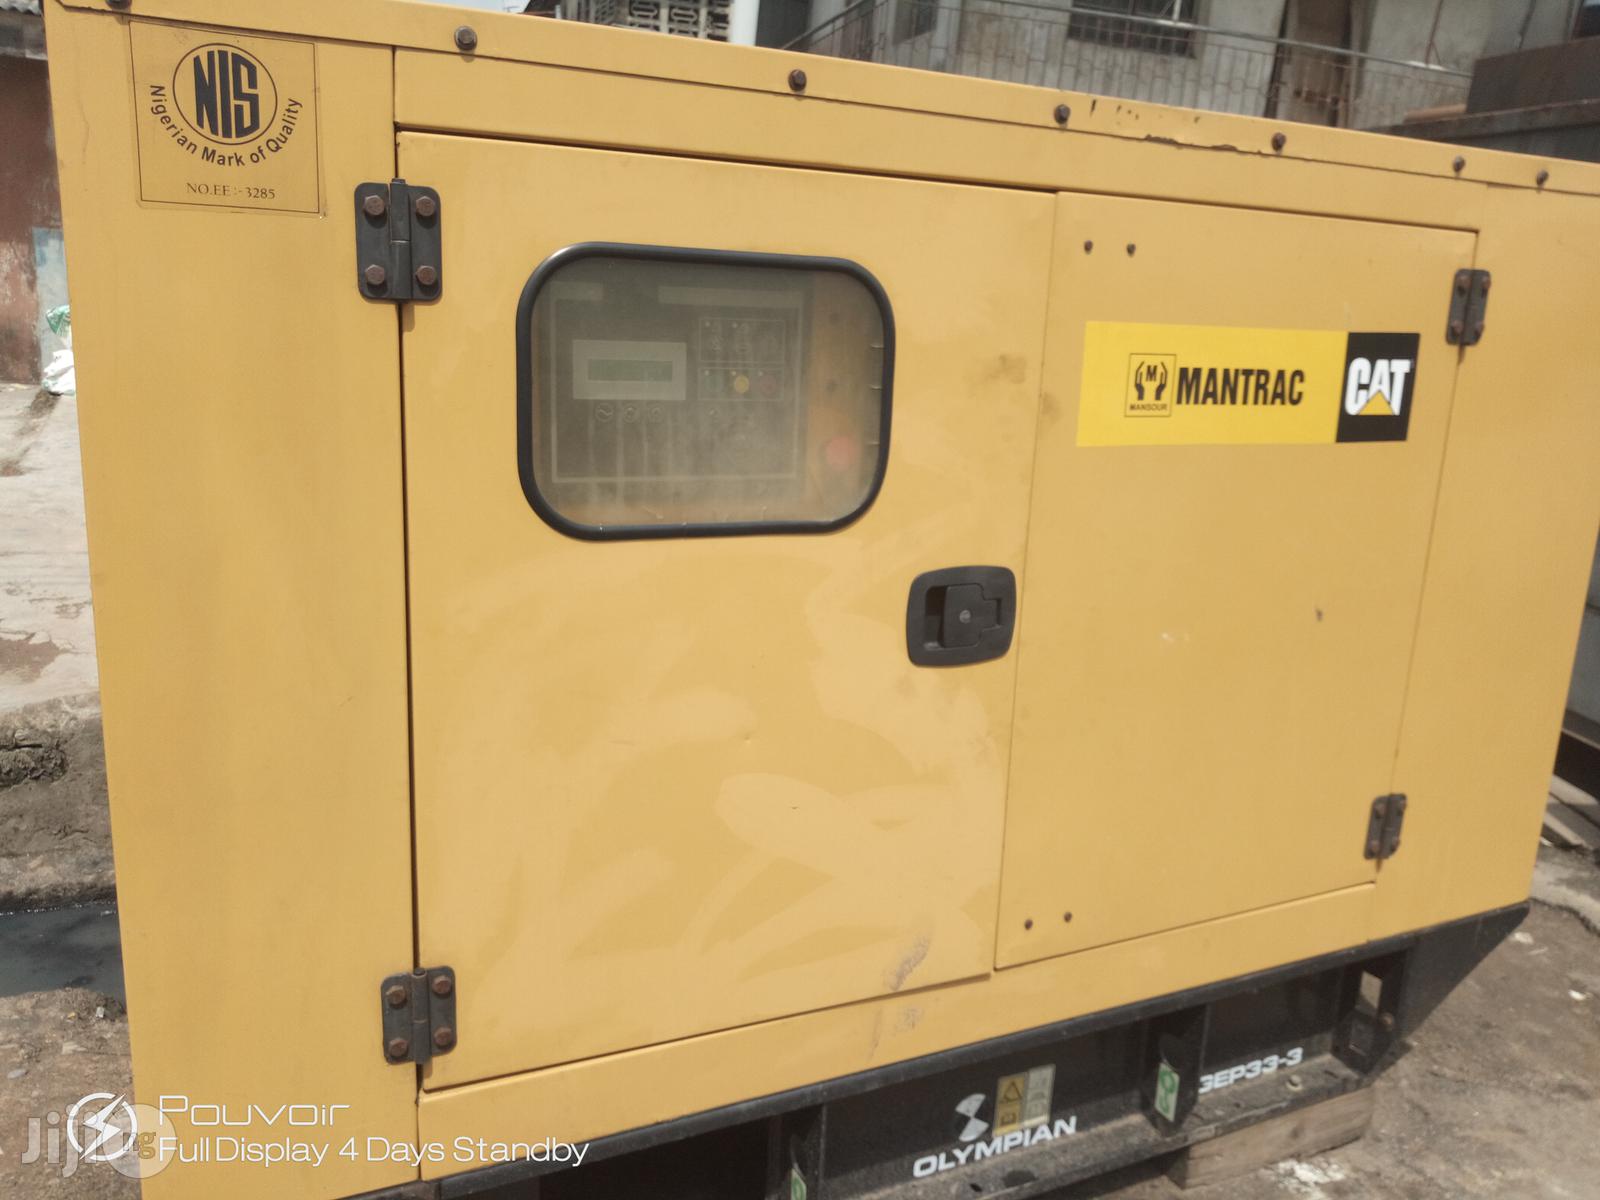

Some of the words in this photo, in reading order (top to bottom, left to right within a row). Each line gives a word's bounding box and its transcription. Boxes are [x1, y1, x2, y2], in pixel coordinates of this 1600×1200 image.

[193, 49, 260, 139] NIS
[149, 84, 198, 154] Nigerian
[201, 146, 246, 167] Mark
[249, 145, 268, 164] of
[265, 97, 303, 153] Quality
[245, 186, 276, 199] 3285
[1176, 367, 1304, 406] MANTRAC
[1345, 357, 1411, 415] CAT
[913, 1116, 1077, 1178] OLYMPIAN
